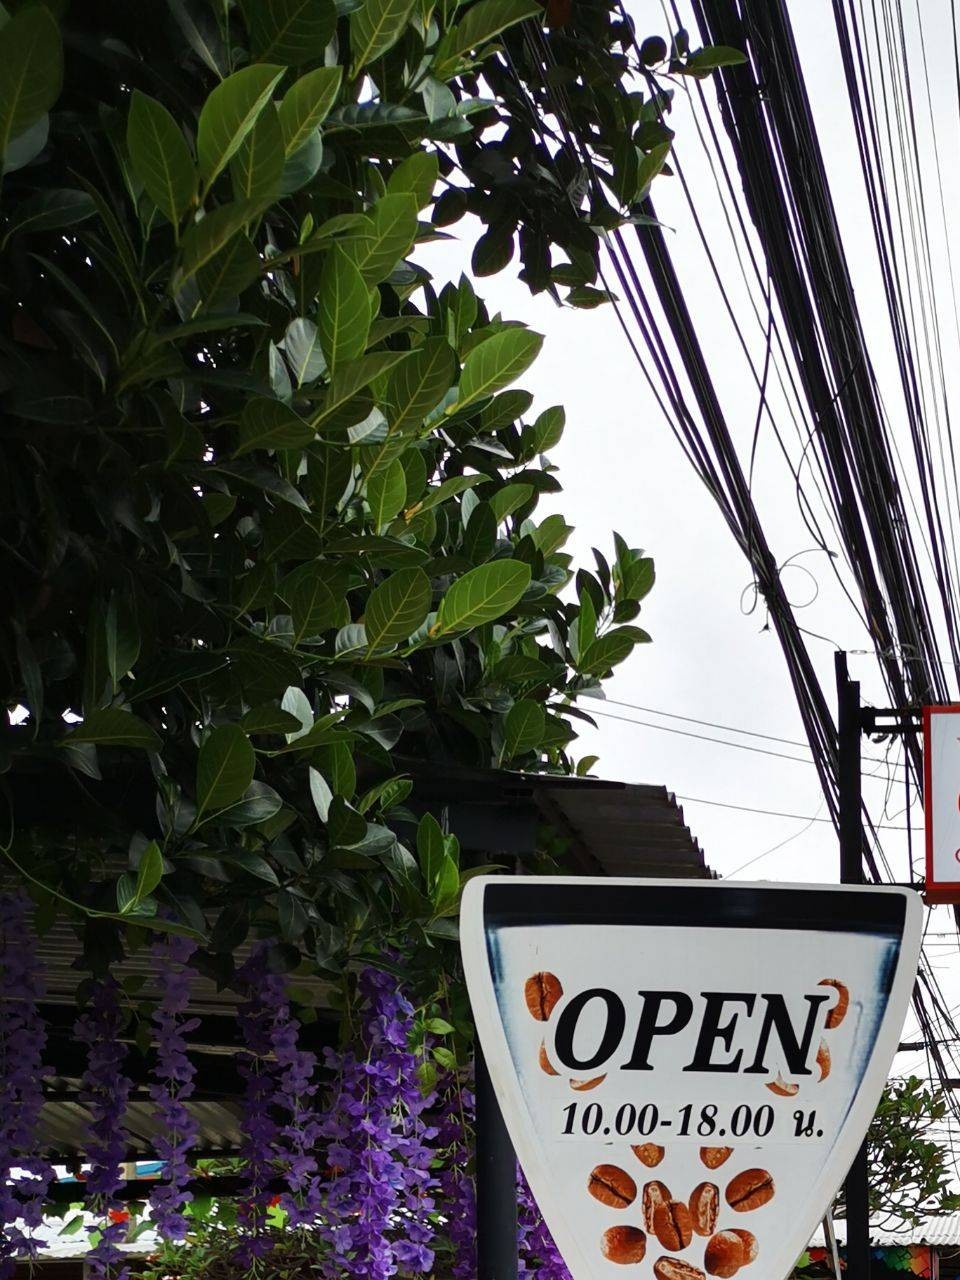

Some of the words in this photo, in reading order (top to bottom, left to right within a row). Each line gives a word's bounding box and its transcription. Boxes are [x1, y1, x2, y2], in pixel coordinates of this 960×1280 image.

[554, 988, 830, 1075] OPEN
[561, 1102, 774, 1138] 10.00-18.00
[793, 1110, 824, 1137] น.
